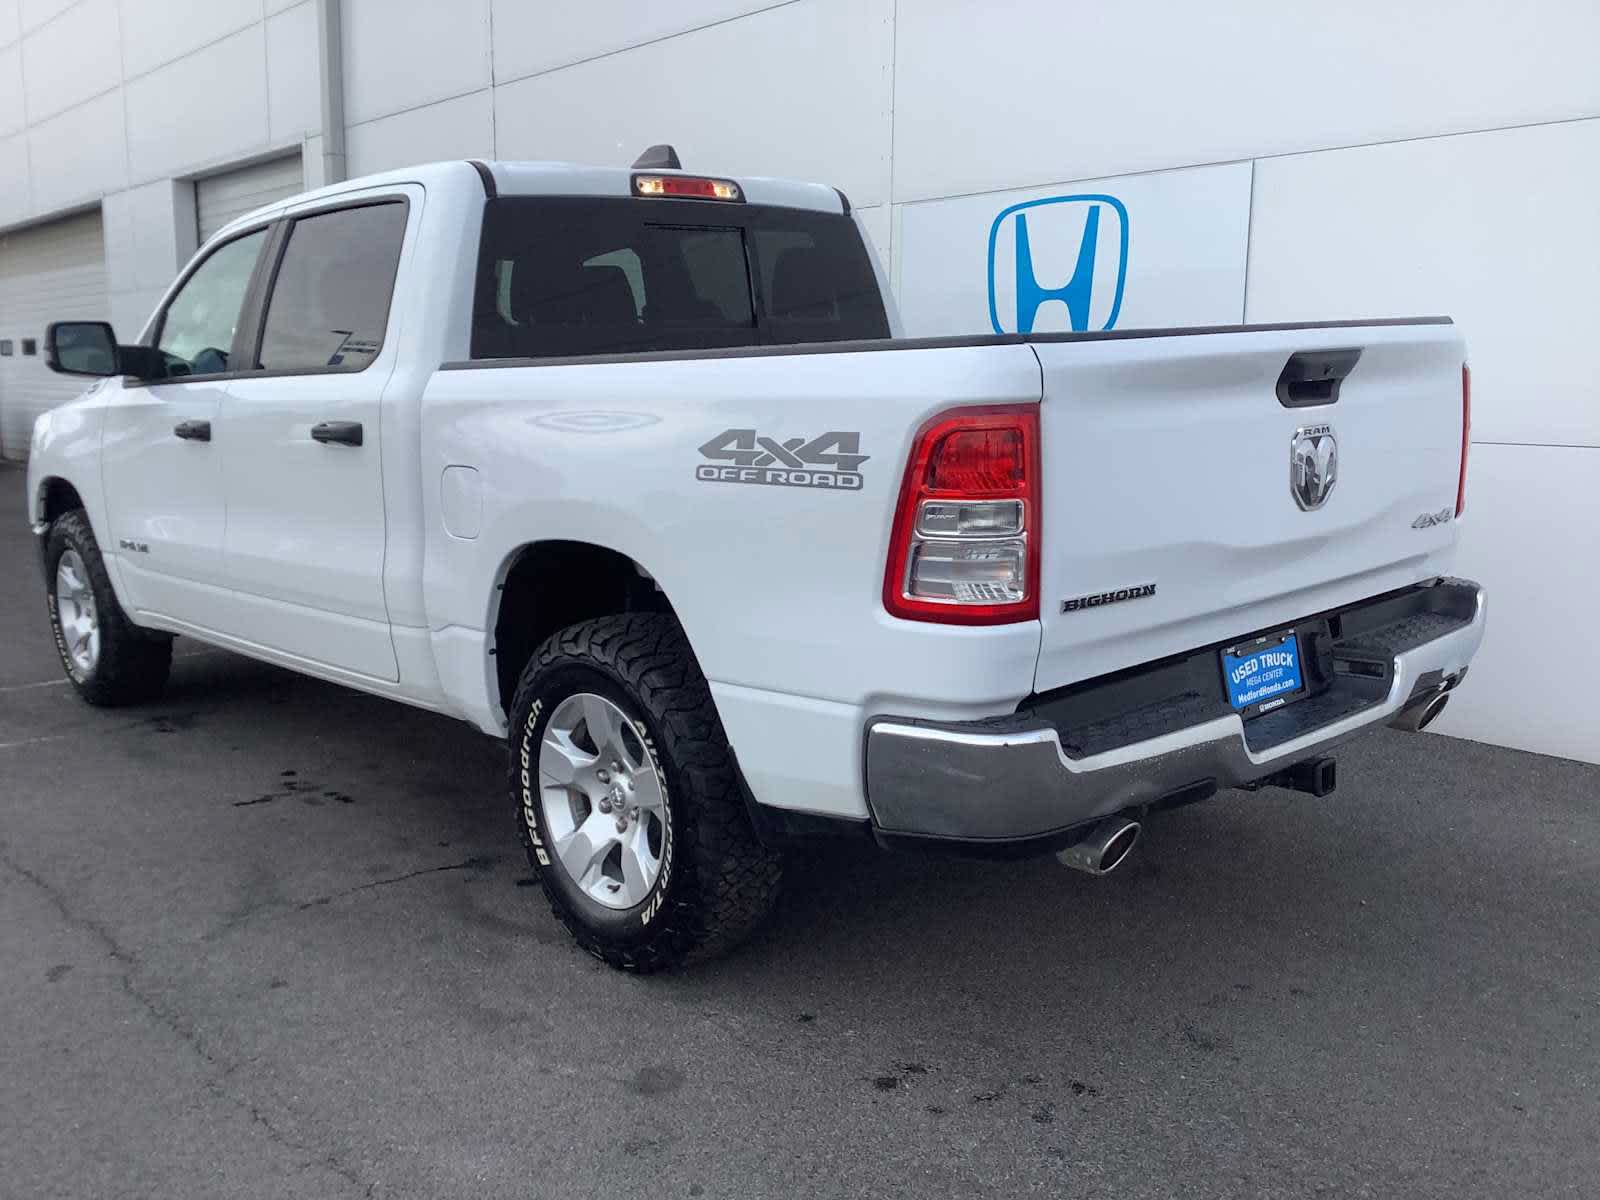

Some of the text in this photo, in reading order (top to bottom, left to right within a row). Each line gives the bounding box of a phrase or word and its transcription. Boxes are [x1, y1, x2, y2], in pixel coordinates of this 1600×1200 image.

[1303, 426, 1331, 436] RAM
[699, 466, 861, 488] OFF ROAD
[1061, 584, 1156, 613] BIGHORN
[1231, 652, 1294, 684] USED TRUCK
[1246, 668, 1285, 688] MEGA CENTER
[1237, 679, 1295, 704] MedfordHonda.com
[520, 698, 548, 867] BFGoodrich
